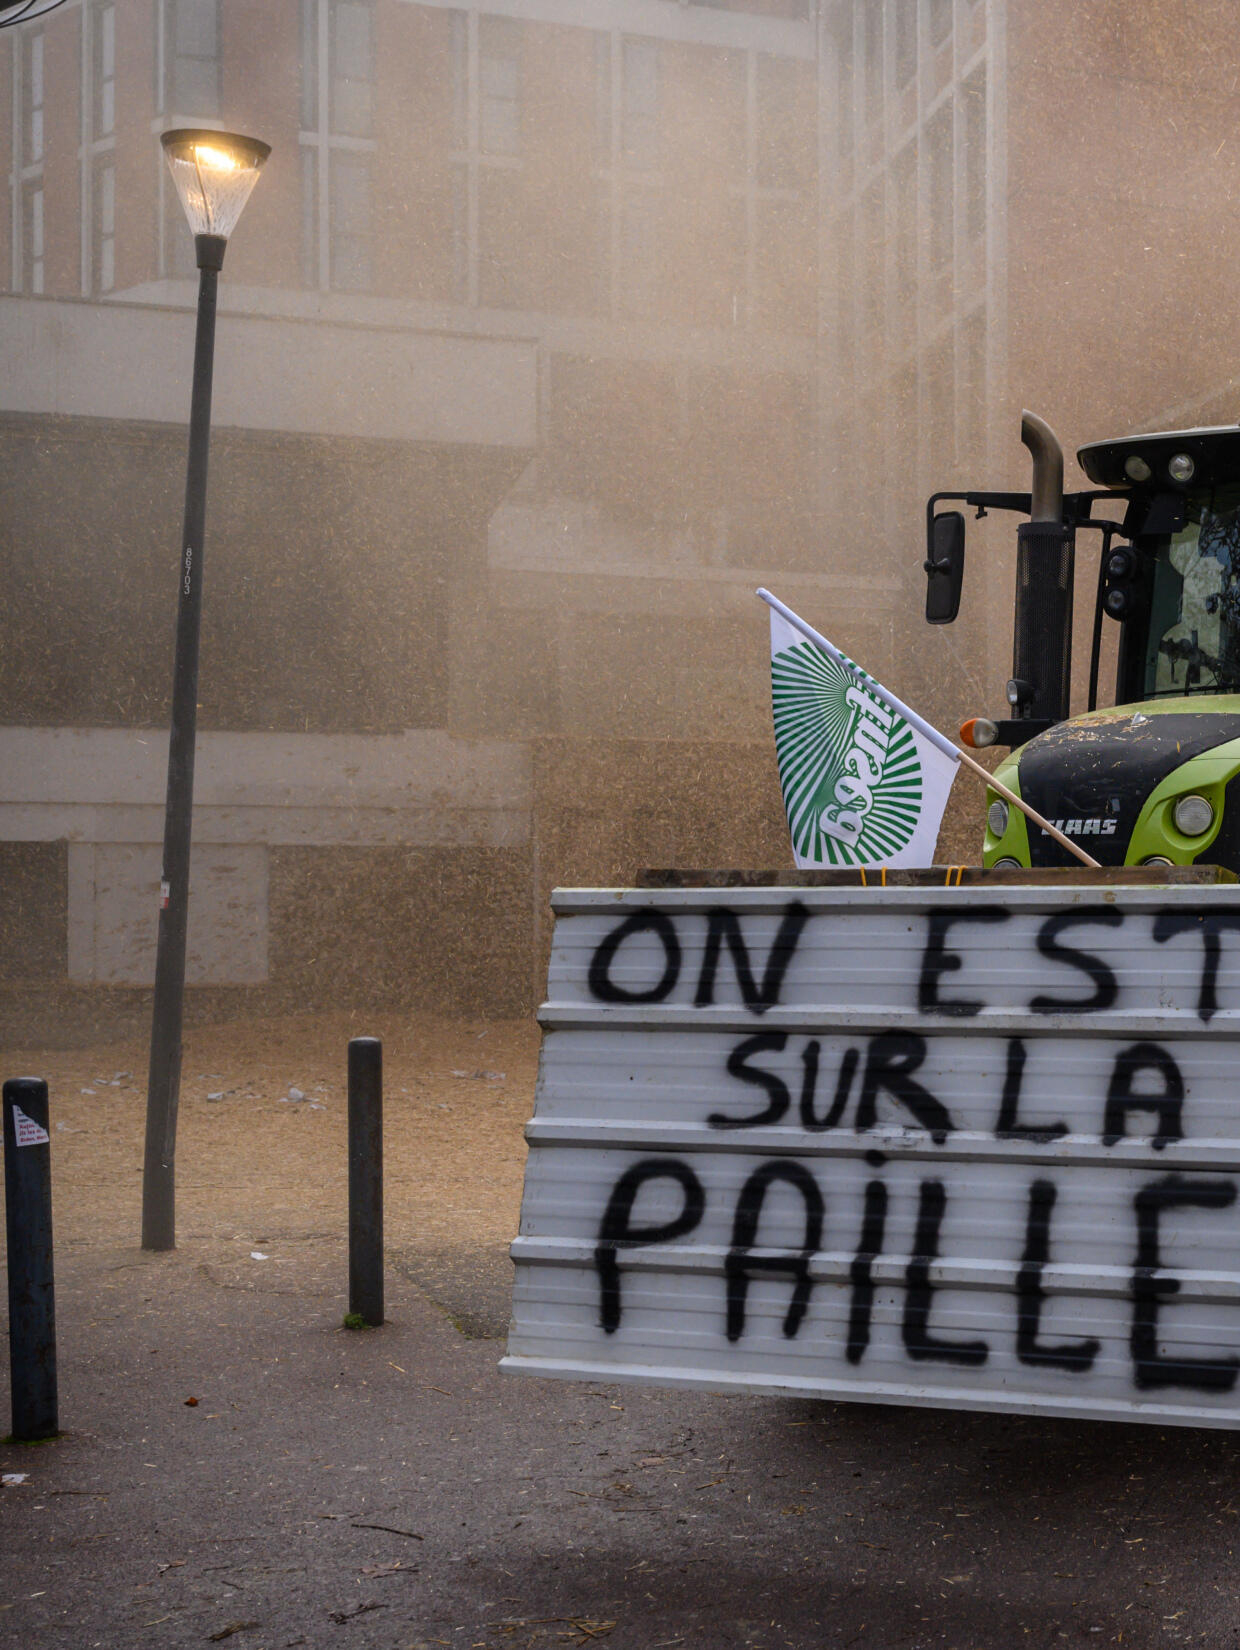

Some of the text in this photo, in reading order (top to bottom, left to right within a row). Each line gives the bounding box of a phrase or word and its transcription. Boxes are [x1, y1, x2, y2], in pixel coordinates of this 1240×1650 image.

[184, 547, 193, 595] 86703
[587, 900, 811, 1013] ON
[707, 1029, 1187, 1150] SUR LA
